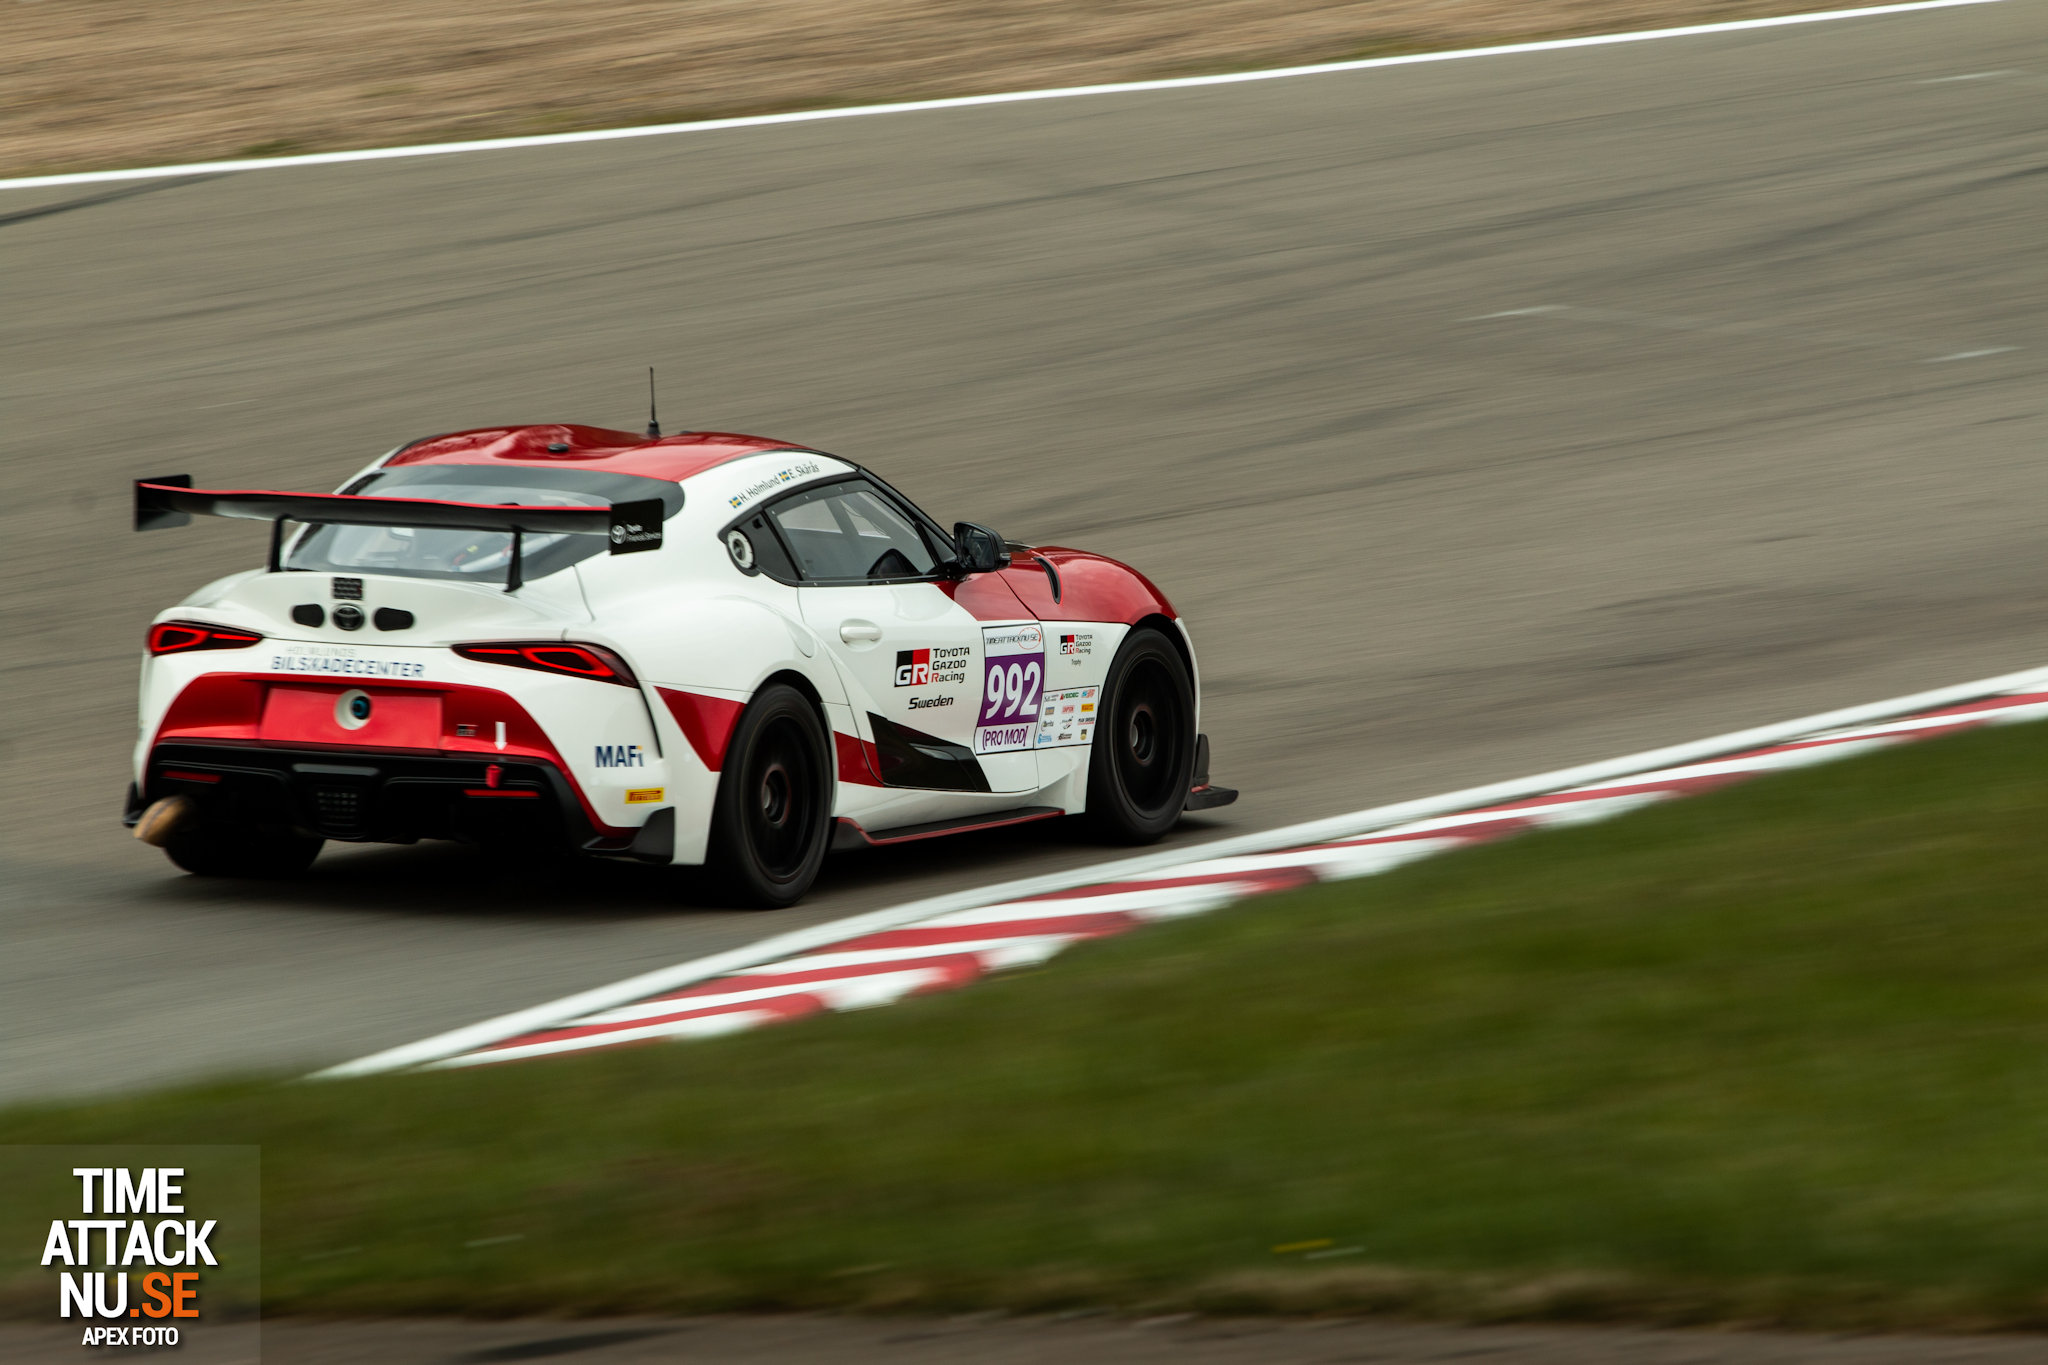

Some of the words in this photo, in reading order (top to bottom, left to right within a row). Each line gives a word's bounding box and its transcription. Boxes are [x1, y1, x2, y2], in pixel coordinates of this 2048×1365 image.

[1060, 642, 1074, 654] GR
[895, 663, 929, 686] GR
[930, 670, 965, 684] Racing
[985, 661, 1041, 719] 992
[908, 695, 954, 710] Sweden
